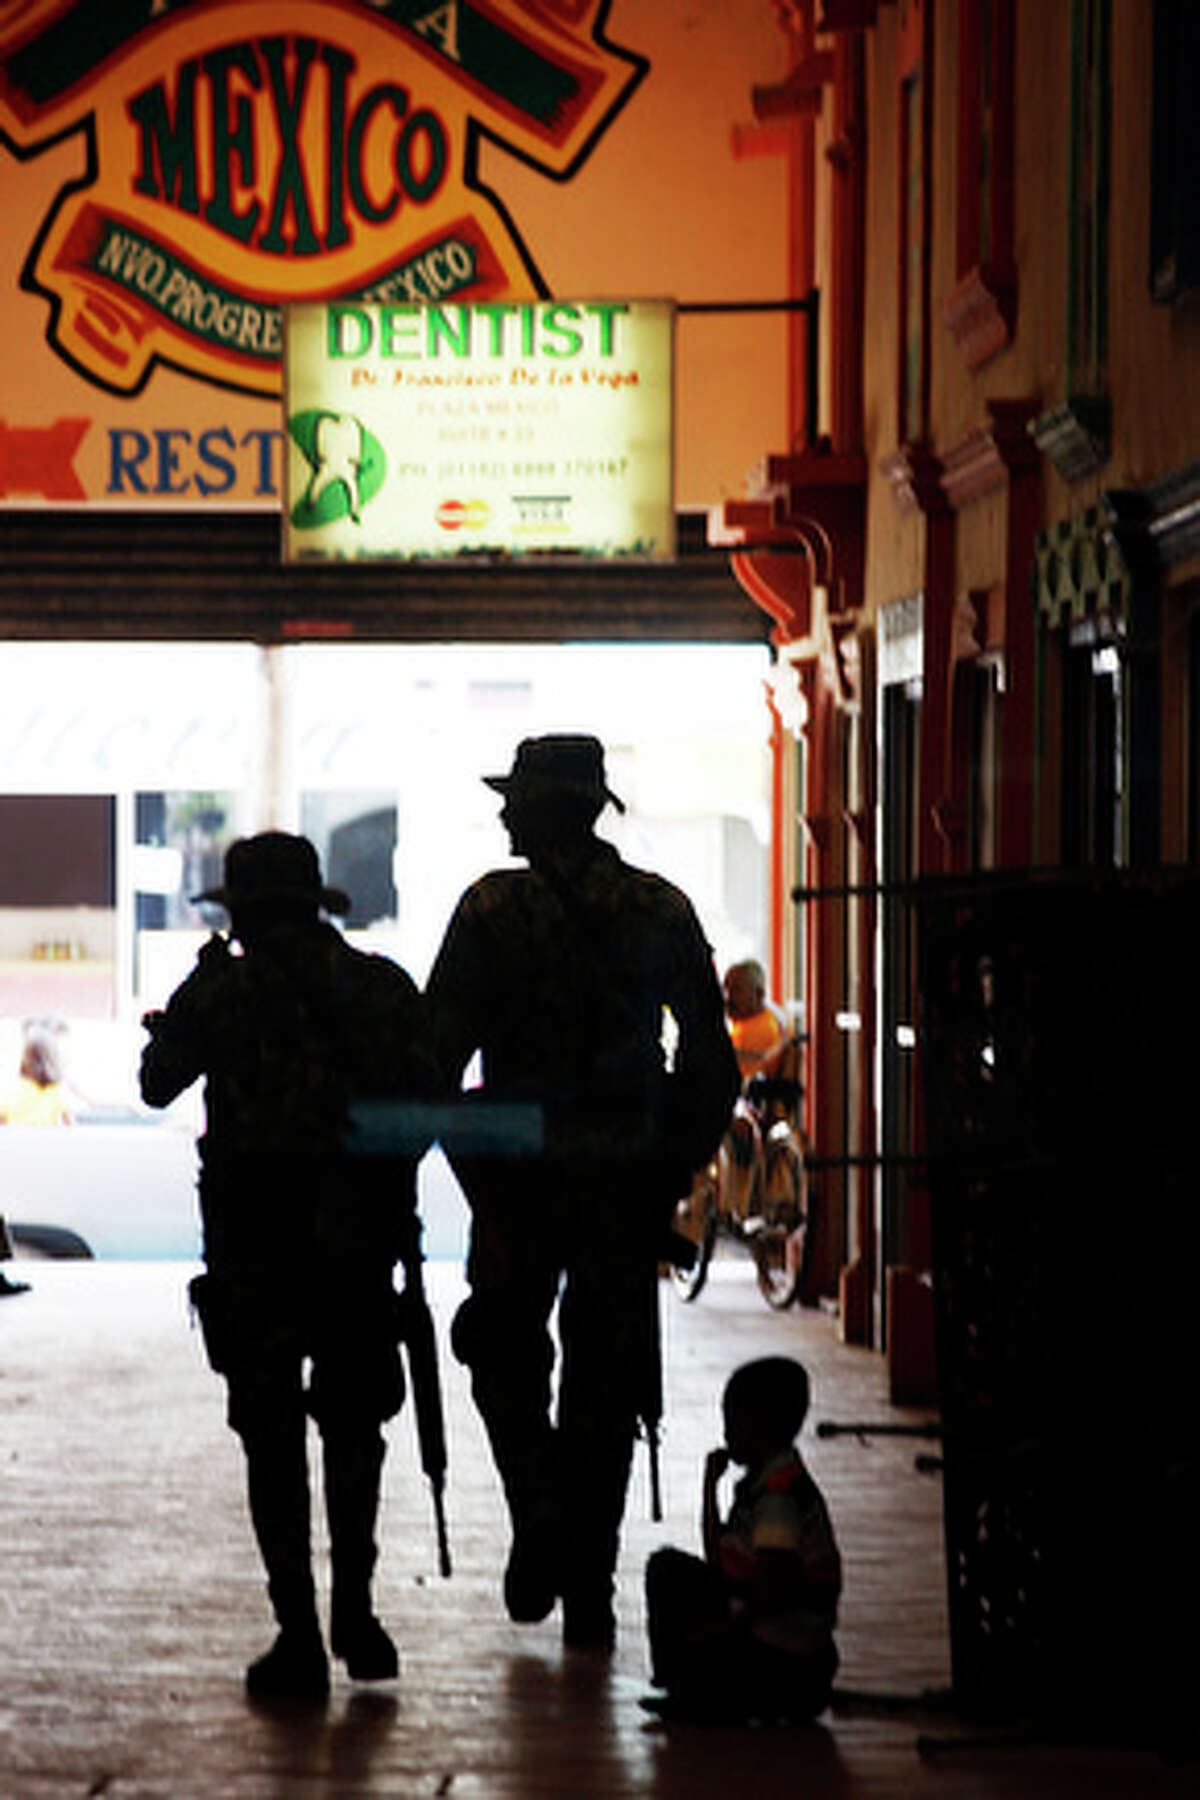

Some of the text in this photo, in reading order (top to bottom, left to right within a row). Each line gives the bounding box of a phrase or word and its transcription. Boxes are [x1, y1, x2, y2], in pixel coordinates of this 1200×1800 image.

[129, 32, 452, 257] MEXICO
[362, 241, 473, 302] EXICO
[326, 302, 630, 360] DENTIST
